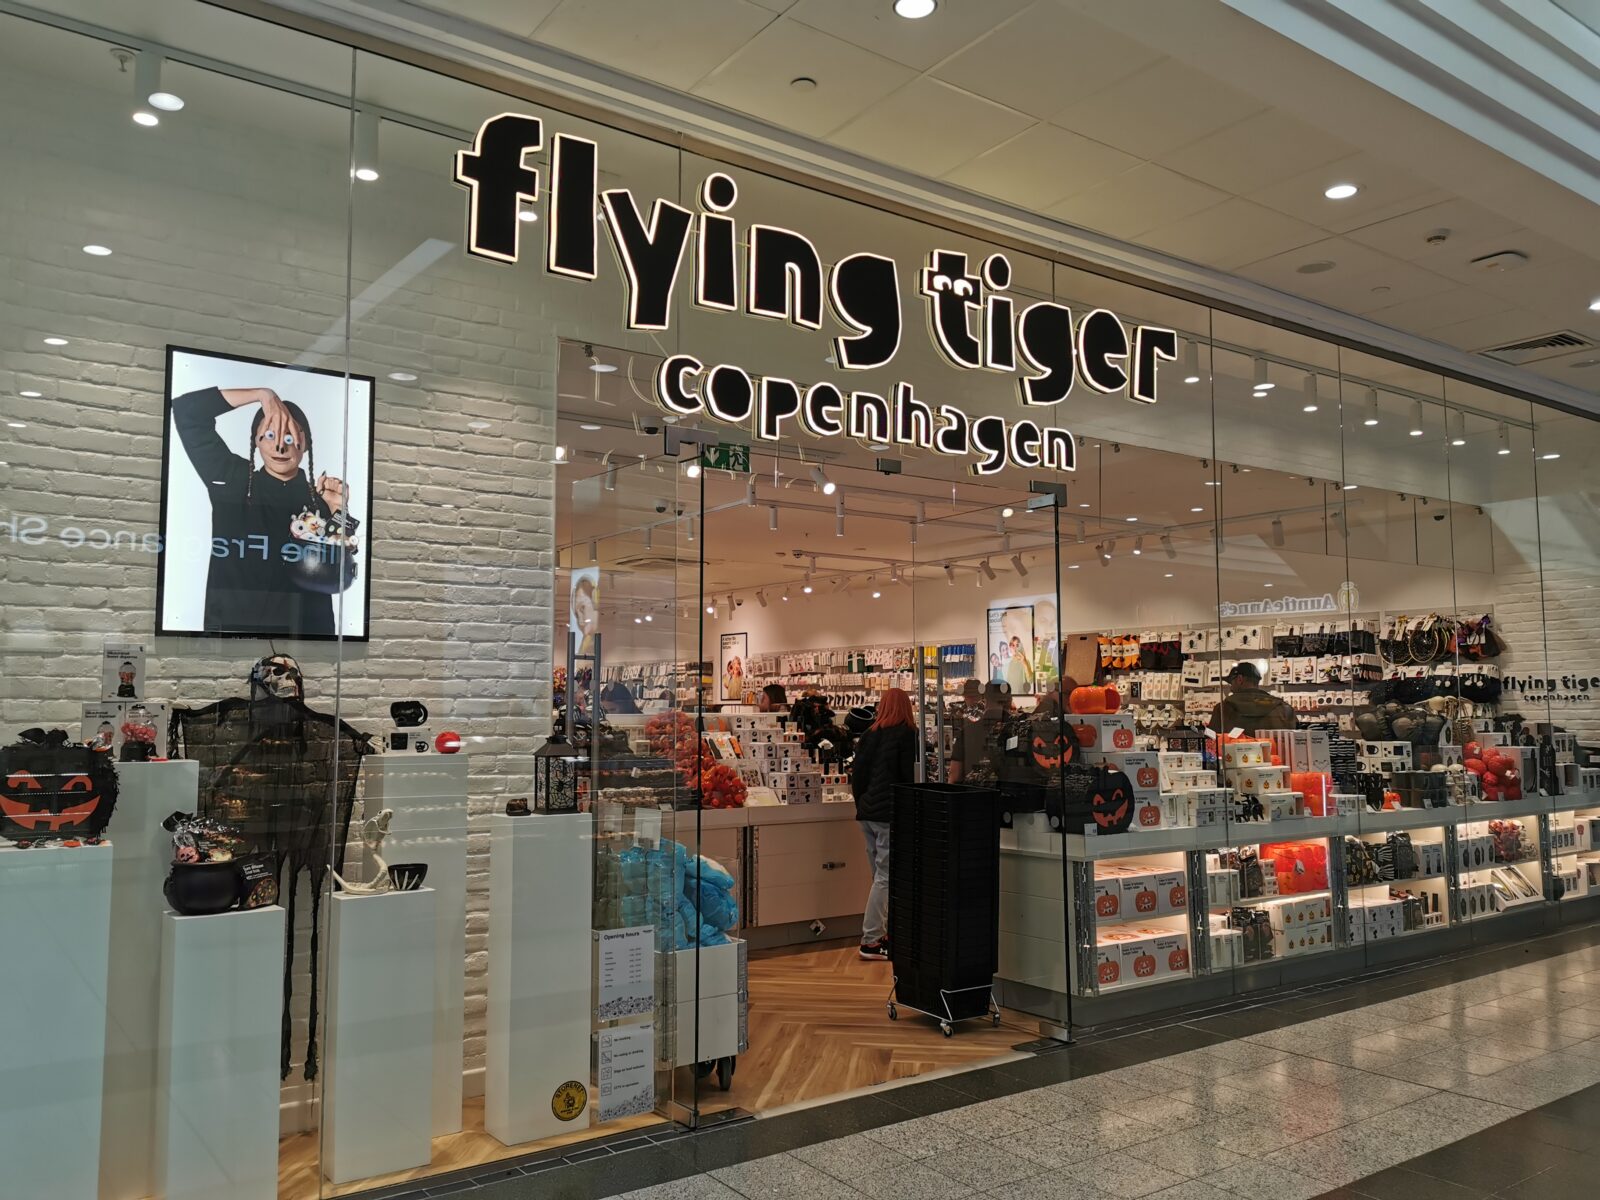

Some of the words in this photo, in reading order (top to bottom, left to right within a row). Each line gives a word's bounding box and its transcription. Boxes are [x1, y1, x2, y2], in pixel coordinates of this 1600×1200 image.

[455, 112, 902, 370] flying
[918, 248, 1177, 406] tiger
[656, 354, 1077, 475] copenhagen
[1502, 675, 1557, 693] flying
[1524, 693, 1590, 703] copenhagen
